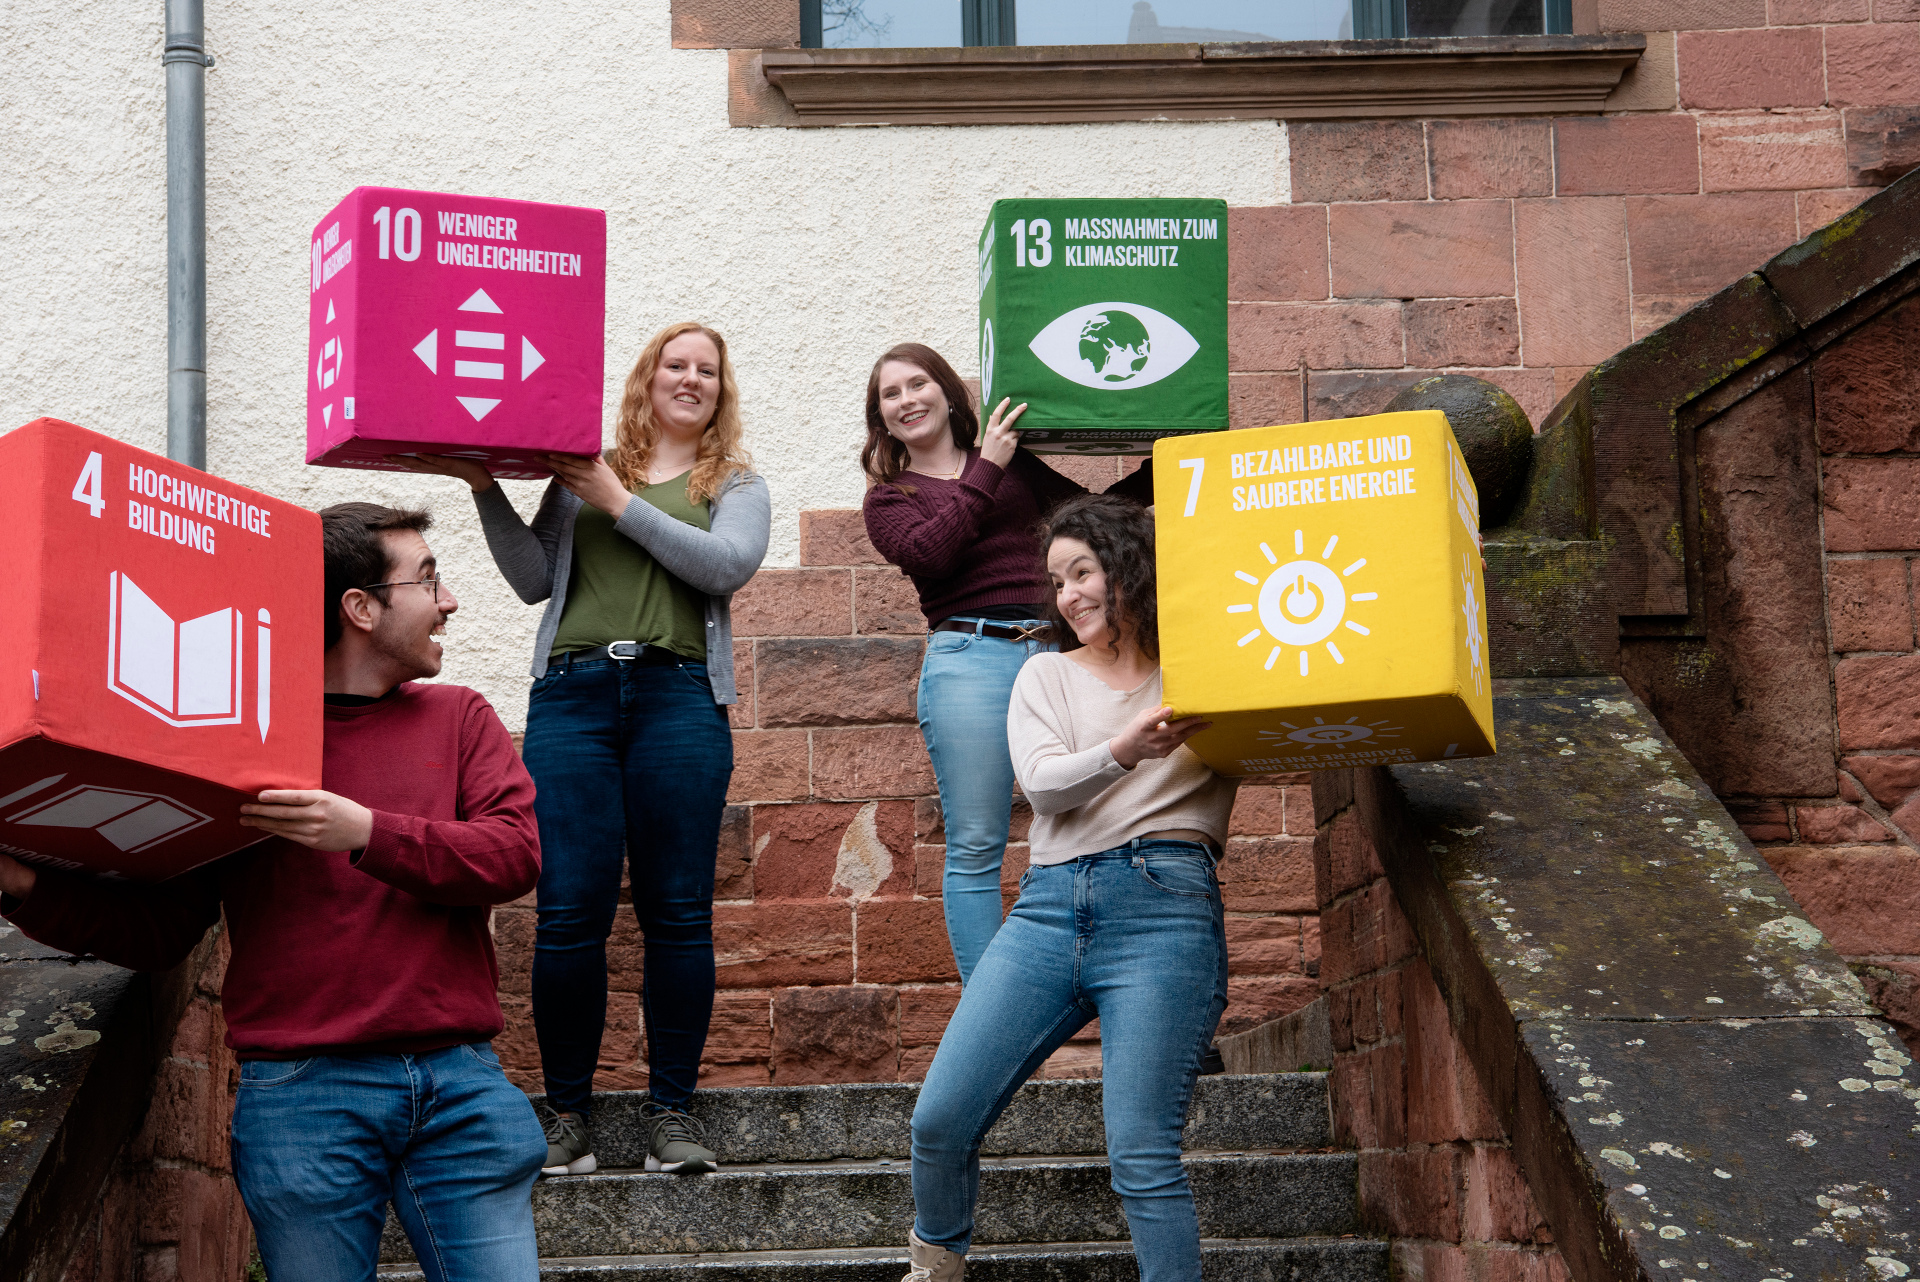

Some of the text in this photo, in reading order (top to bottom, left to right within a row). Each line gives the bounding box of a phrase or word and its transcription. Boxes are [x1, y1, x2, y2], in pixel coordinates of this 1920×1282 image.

[373, 206, 422, 262] 10
[438, 211, 517, 241] WENIGER
[1011, 219, 1052, 267] 13
[1065, 218, 1218, 240] MASSNAHMEN ZUM
[437, 241, 581, 276] UNGLEICHHEITEN
[1065, 246, 1179, 267] KLIMASCHUTZ
[1231, 435, 1412, 479] BEZAHLBARE UND
[72, 451, 106, 518] 4
[129, 463, 271, 538] HOCHWERTIGE
[1179, 458, 1205, 517] 7
[1232, 468, 1416, 511] SAUBERE ENERGIE
[129, 500, 215, 555] BILDUNG
[1236, 748, 1412, 766] SAUBERE ENERGIE
[1244, 754, 1417, 772] BEZAHLBARE UND
